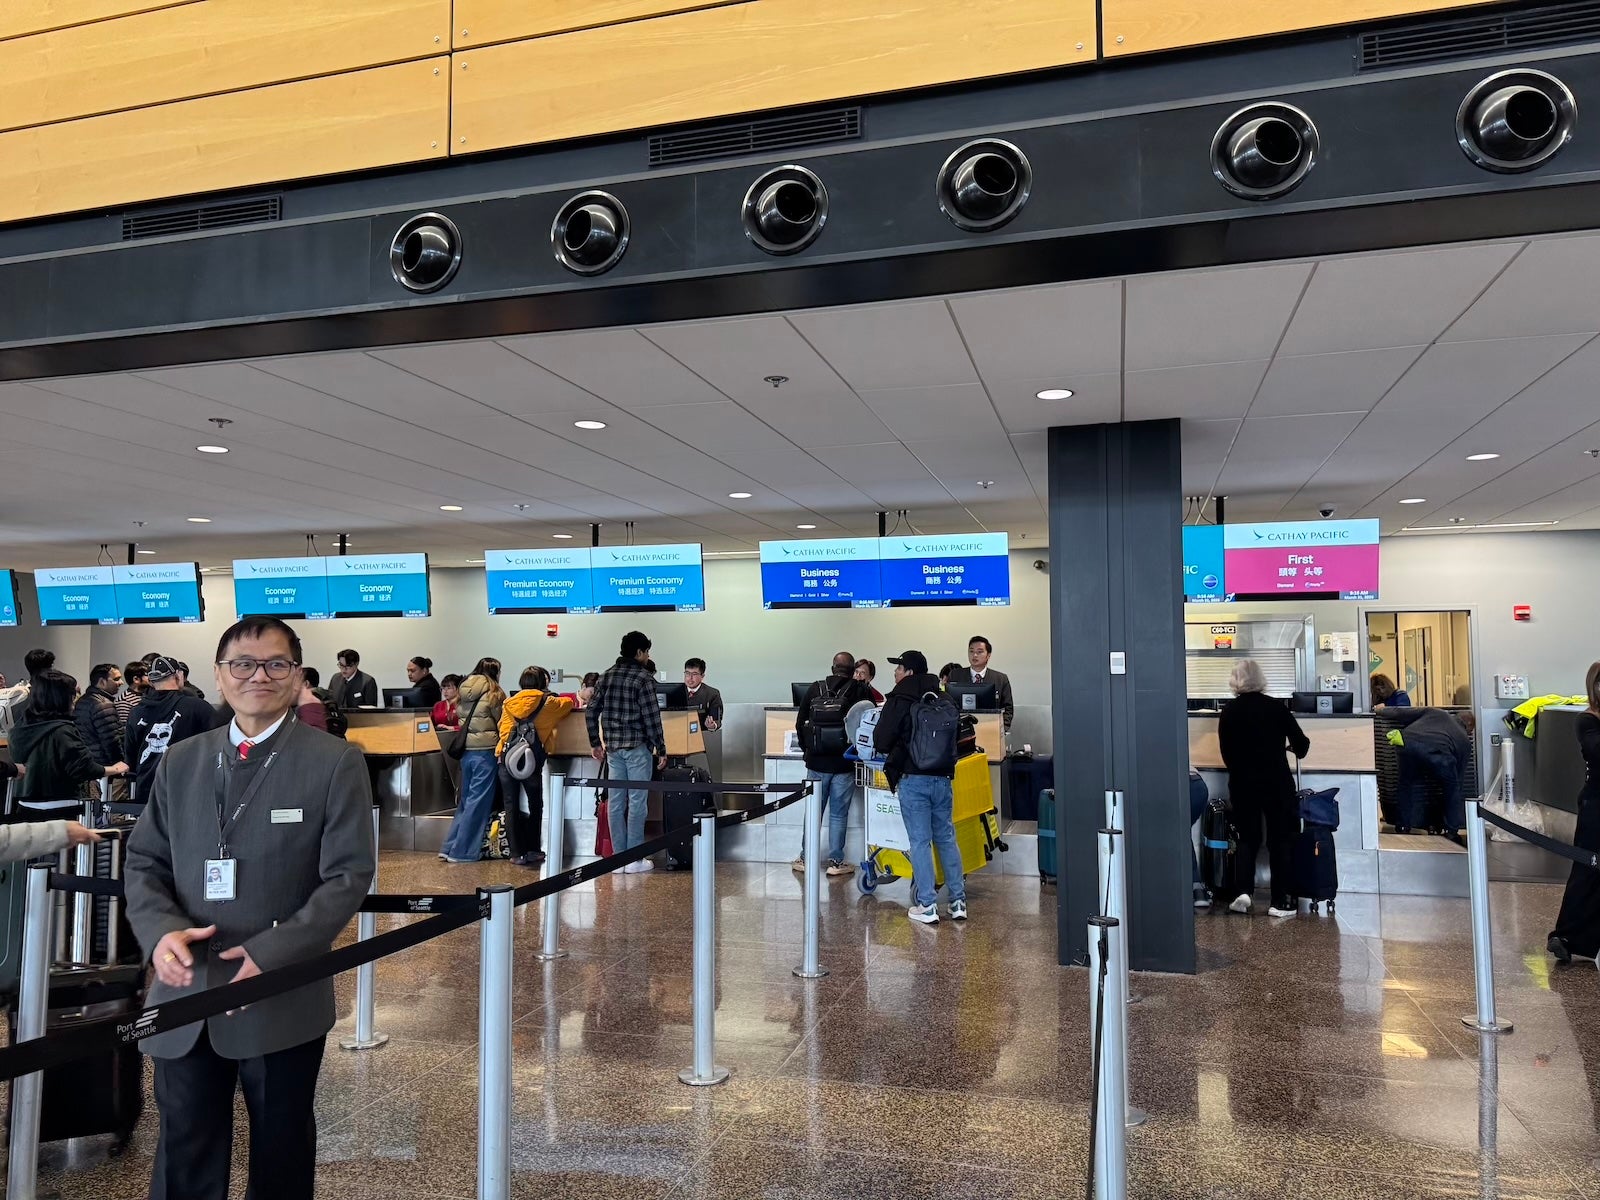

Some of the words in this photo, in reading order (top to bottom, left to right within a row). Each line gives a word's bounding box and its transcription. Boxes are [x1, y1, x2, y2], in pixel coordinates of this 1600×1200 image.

[1268, 532, 1308, 541] CATHAY
[1310, 531, 1349, 540] PACIFIC
[794, 548, 824, 556] CATHAY
[915, 544, 949, 552] CATHAY
[950, 543, 982, 551] PACIFIC
[515, 557, 542, 565] CATHAY
[544, 556, 571, 564] PACIFIC
[622, 554, 650, 562] CATHAY
[1288, 555, 1314, 564] First
[259, 566, 283, 574] CATHAY
[381, 562, 406, 570] PACIFIC
[923, 565, 964, 574] Business
[159, 570, 180, 578] PACIFIC
[800, 568, 839, 577] Business
[1304, 567, 1323, 576] 头等
[504, 580, 537, 588] Premium
[539, 580, 574, 589] Economy
[610, 578, 645, 586] Premium
[646, 576, 684, 586] Economy
[823, 580, 837, 588] 公务
[946, 576, 962, 584] 公务
[265, 587, 296, 595] Economy
[360, 584, 393, 593] Economy
[63, 594, 90, 602] Economy
[142, 592, 170, 600] Economy
[876, 803, 894, 814] SEA
[117, 1023, 133, 1034] Port
[122, 1031, 130, 1041] of
[131, 1025, 157, 1039] Seattle
